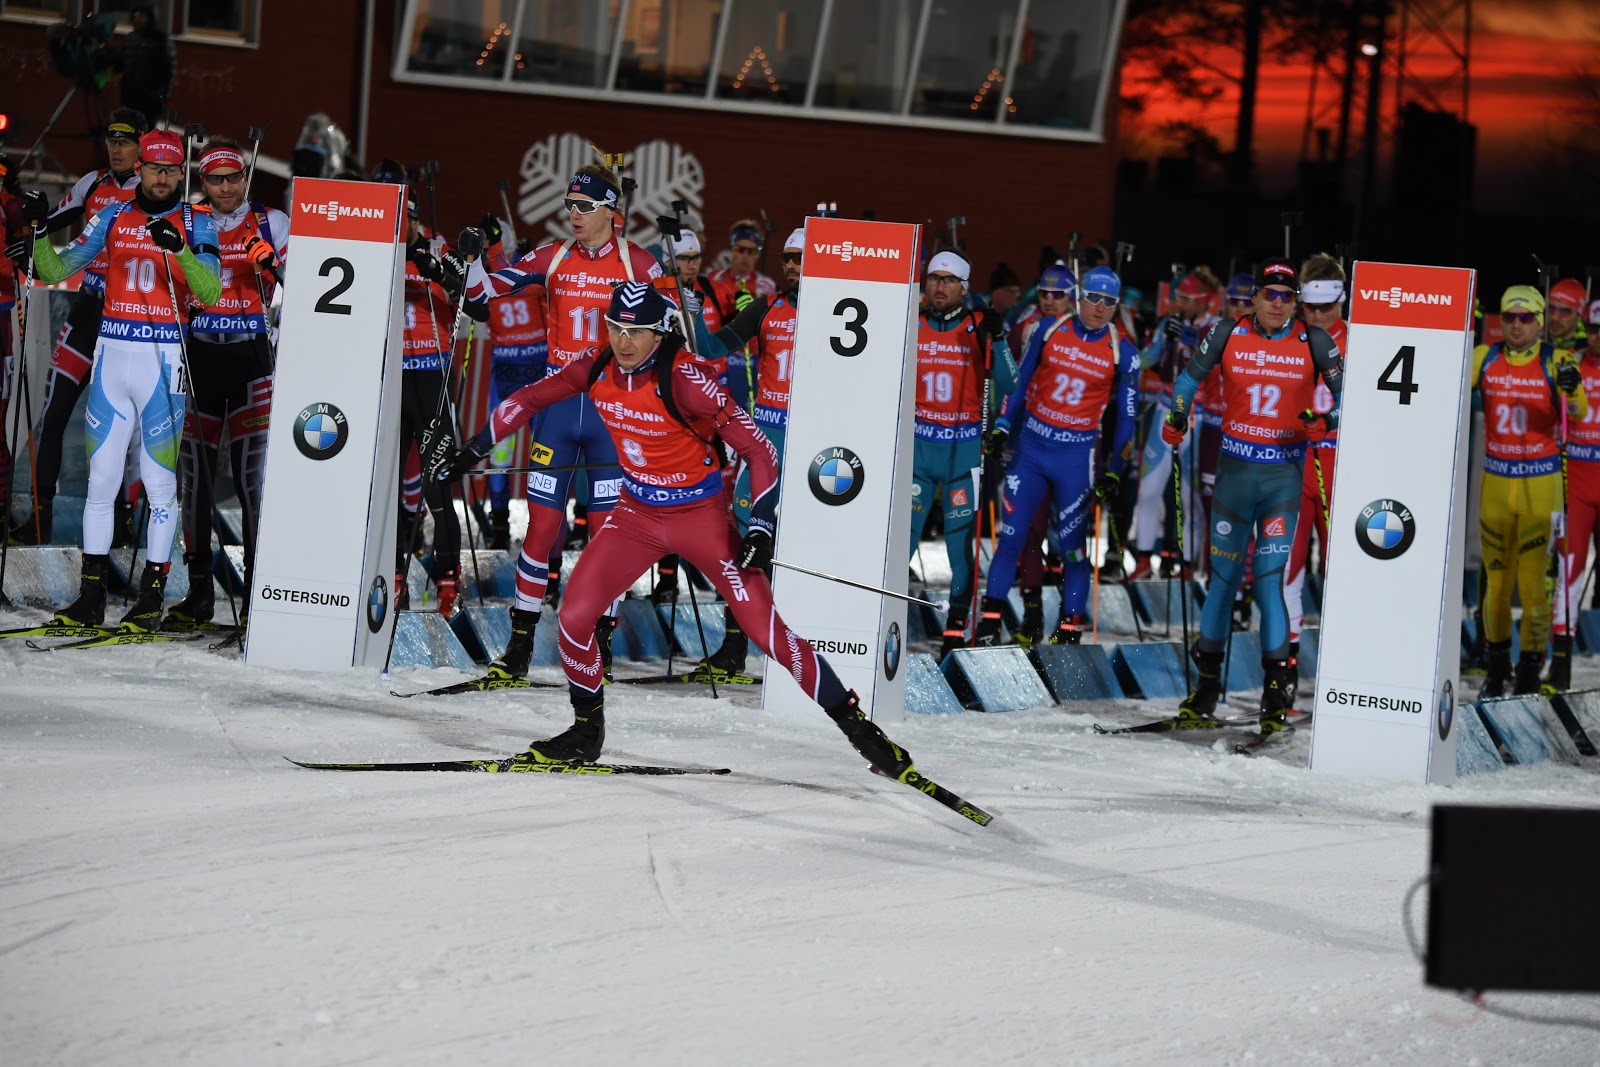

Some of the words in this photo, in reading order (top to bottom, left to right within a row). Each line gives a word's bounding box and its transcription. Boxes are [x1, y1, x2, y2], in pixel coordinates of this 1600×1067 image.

[184, 204, 193, 231] Lumar
[300, 201, 384, 221] VIESSMANN
[814, 241, 899, 262] VIESSMANN
[125, 257, 157, 293] 10
[314, 257, 354, 315] 2
[567, 289, 580, 297] sind
[1360, 287, 1452, 309] VIESSMANN
[111, 300, 171, 316] ÖSTERSUND
[500, 301, 529, 328] 33
[102, 320, 130, 336] BMW
[132, 326, 179, 339] xDrive
[211, 317, 258, 330] xDrive
[569, 306, 600, 342] 11
[829, 298, 869, 357] 3
[1053, 344, 1110, 368] VIESSMANN
[1235, 350, 1304, 367] VIESSMANN
[1245, 366, 1259, 375] sind
[1261, 368, 1303, 379] #Winterfans
[1377, 346, 1418, 405] 4
[922, 371, 952, 403] 19
[1051, 373, 1086, 406] 23
[1246, 383, 1281, 418] 12
[300, 403, 345, 425] BMW
[1496, 403, 1528, 436] 20
[936, 427, 977, 440] xDrive
[1230, 420, 1295, 438] ÖSTERSUND
[622, 438, 647, 467] 8
[815, 448, 861, 469] BMW
[1222, 438, 1253, 458] BMW
[1256, 448, 1300, 460] xDrive
[1511, 461, 1553, 475] xDrive
[1362, 500, 1412, 523] BMW
[261, 585, 350, 607] ÖSTERSUND
[44, 629, 99, 637] FISCHER
[117, 635, 155, 645] FISCHER
[488, 680, 531, 689] FISCHER
[694, 673, 754, 685] FISCHER
[1326, 688, 1423, 714] ÖSTERSUND
[509, 763, 613, 776] FISCHER
